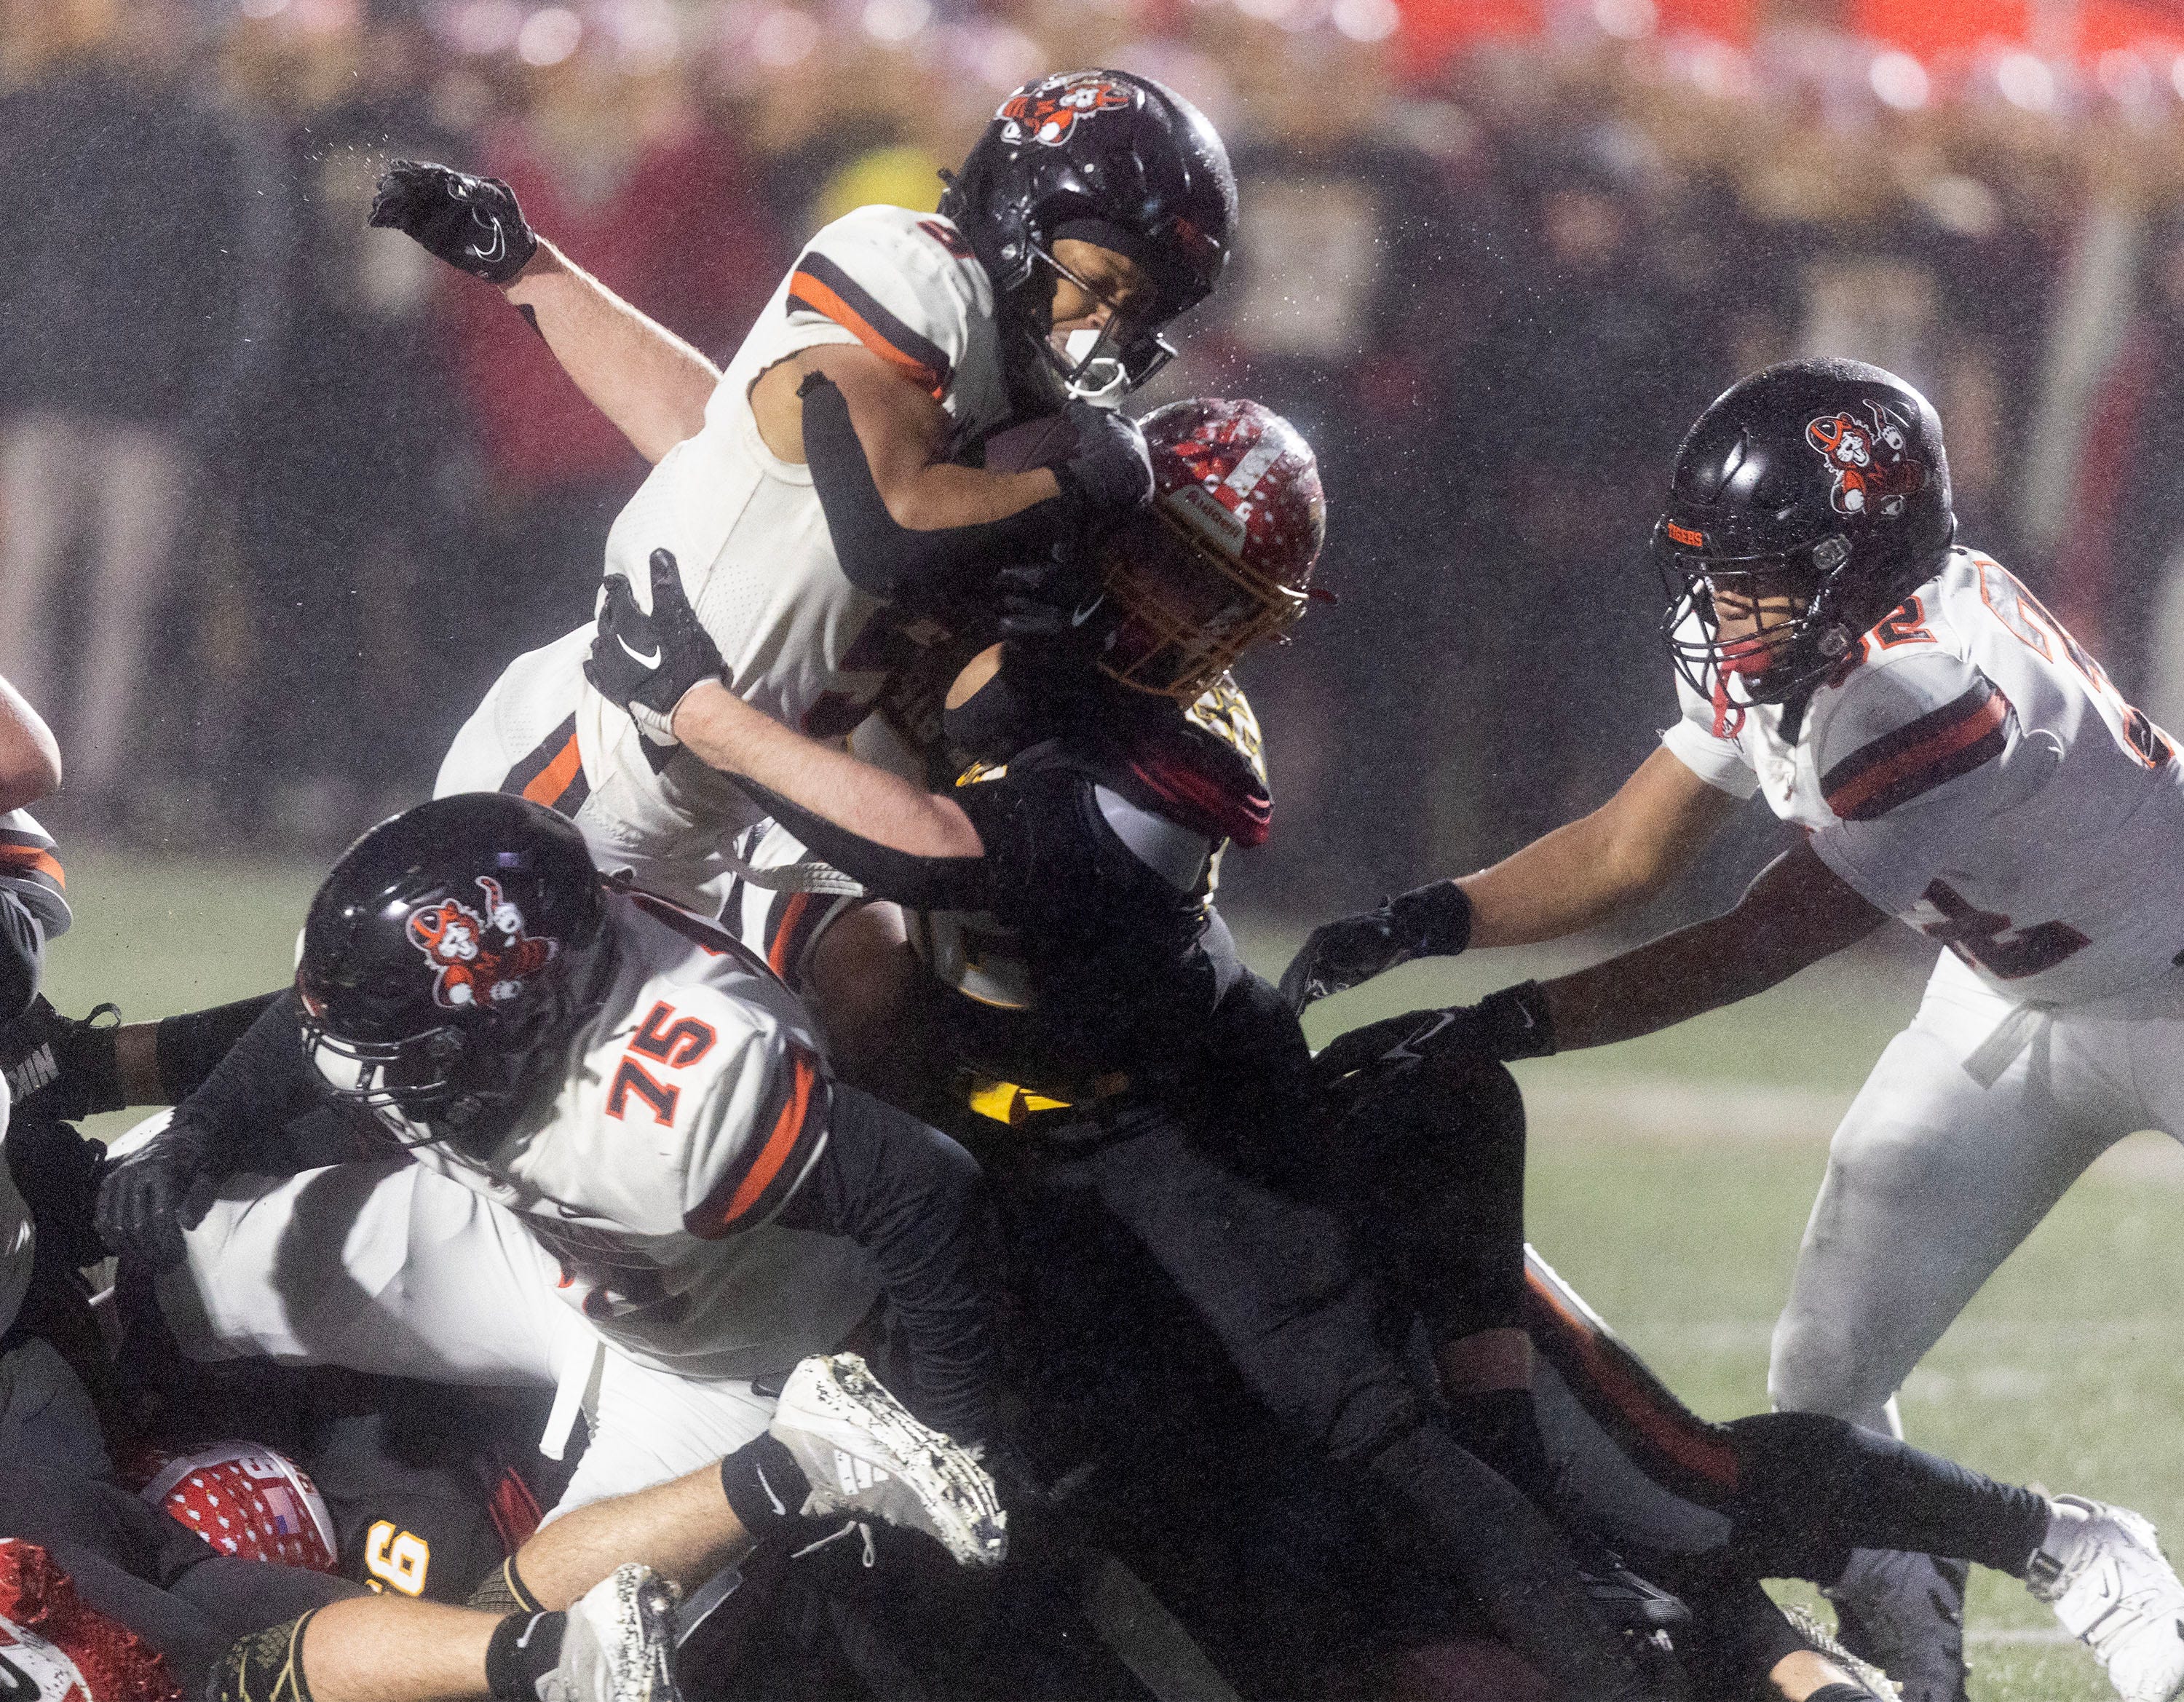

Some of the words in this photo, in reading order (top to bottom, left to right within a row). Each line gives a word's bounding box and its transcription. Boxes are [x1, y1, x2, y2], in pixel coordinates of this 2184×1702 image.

[1668, 523, 1703, 547] TIGERS
[5, 1042, 59, 1102] NIK
[605, 1000, 718, 1128] 75
